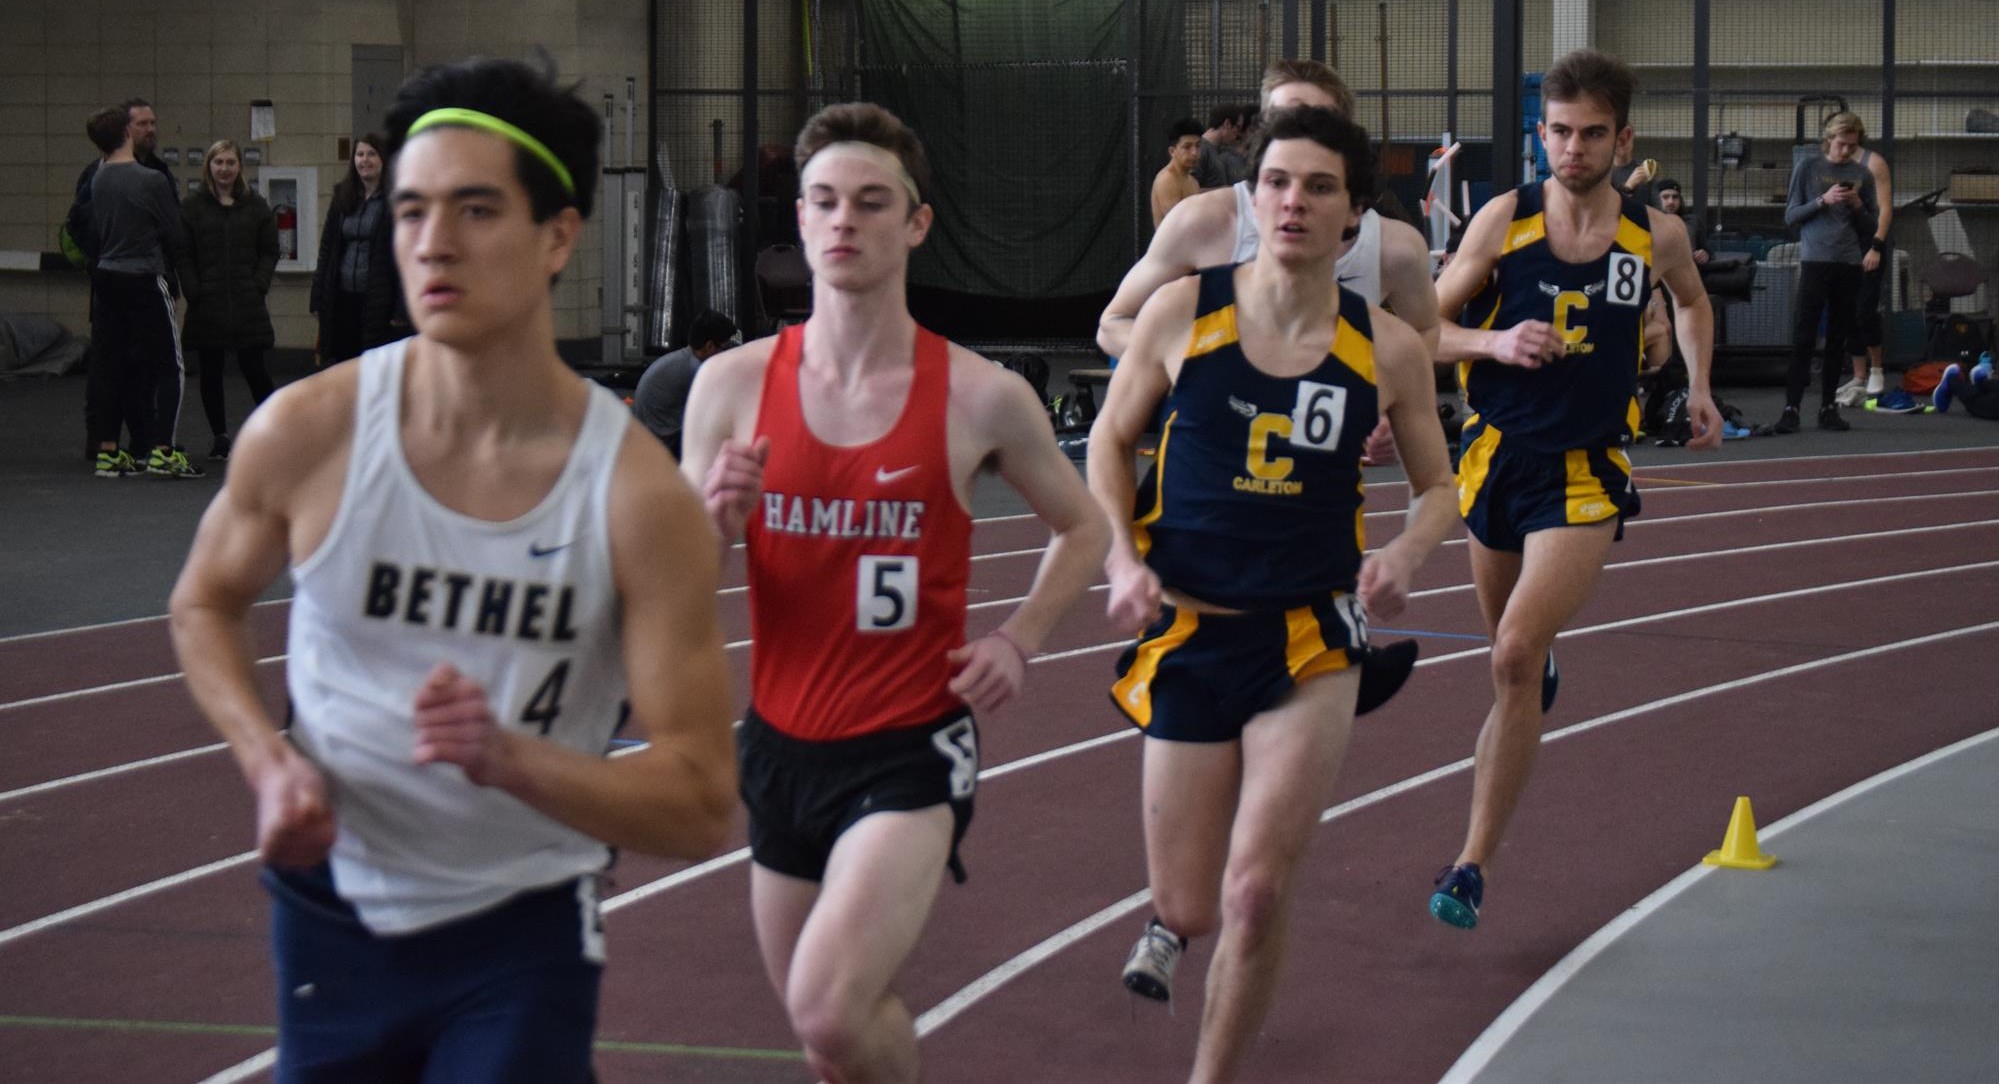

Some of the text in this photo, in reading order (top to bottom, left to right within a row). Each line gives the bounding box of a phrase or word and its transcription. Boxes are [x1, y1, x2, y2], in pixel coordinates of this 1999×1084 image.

[1614, 256, 1637, 301] 8
[1553, 290, 1590, 344] C
[1246, 412, 1294, 480] C
[1303, 387, 1335, 446] 6
[1232, 476, 1303, 495] CARLETON
[763, 491, 925, 540] HAMLINE
[363, 560, 579, 642] BETHEL
[871, 560, 906, 628] 5
[519, 656, 573, 736] 4
